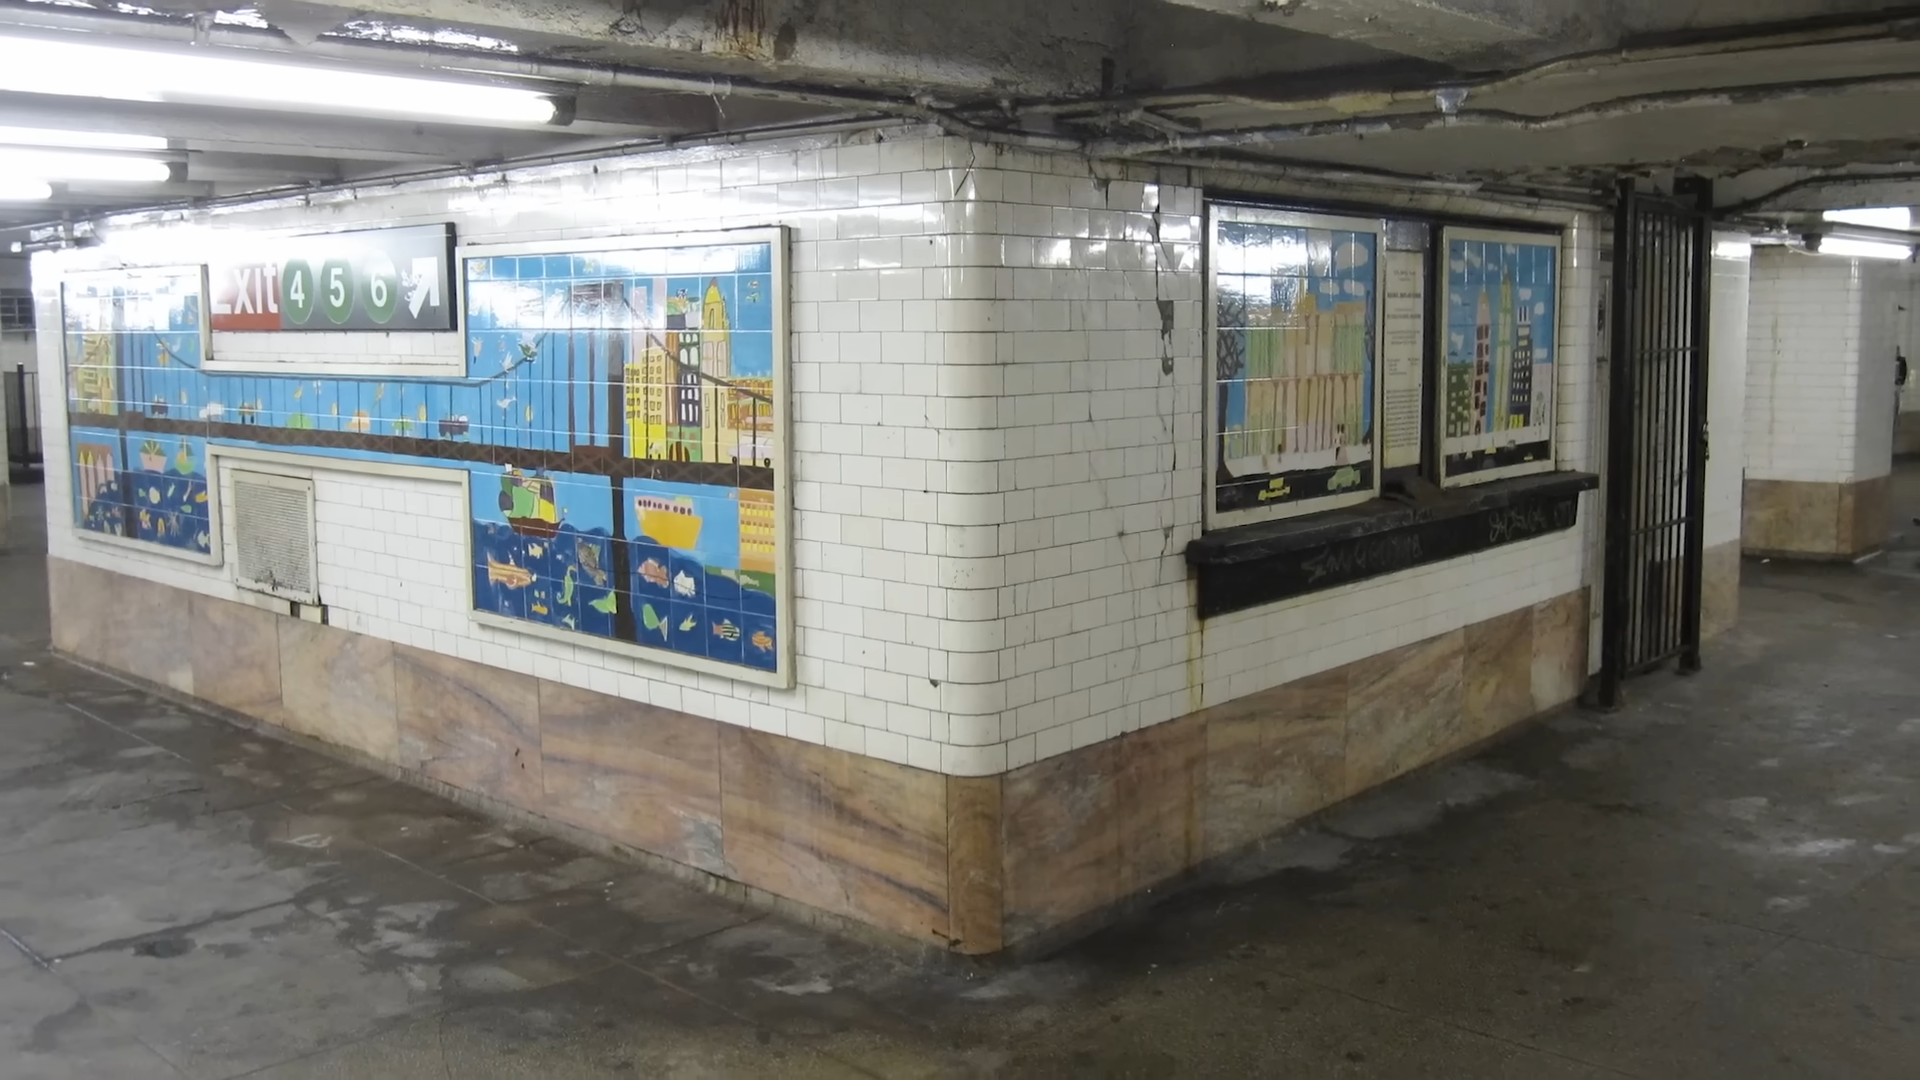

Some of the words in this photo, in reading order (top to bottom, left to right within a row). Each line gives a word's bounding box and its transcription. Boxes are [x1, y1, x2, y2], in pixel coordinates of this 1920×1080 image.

[290, 270, 305, 308] 4
[329, 267, 345, 308] 5
[370, 267, 387, 307] 6
